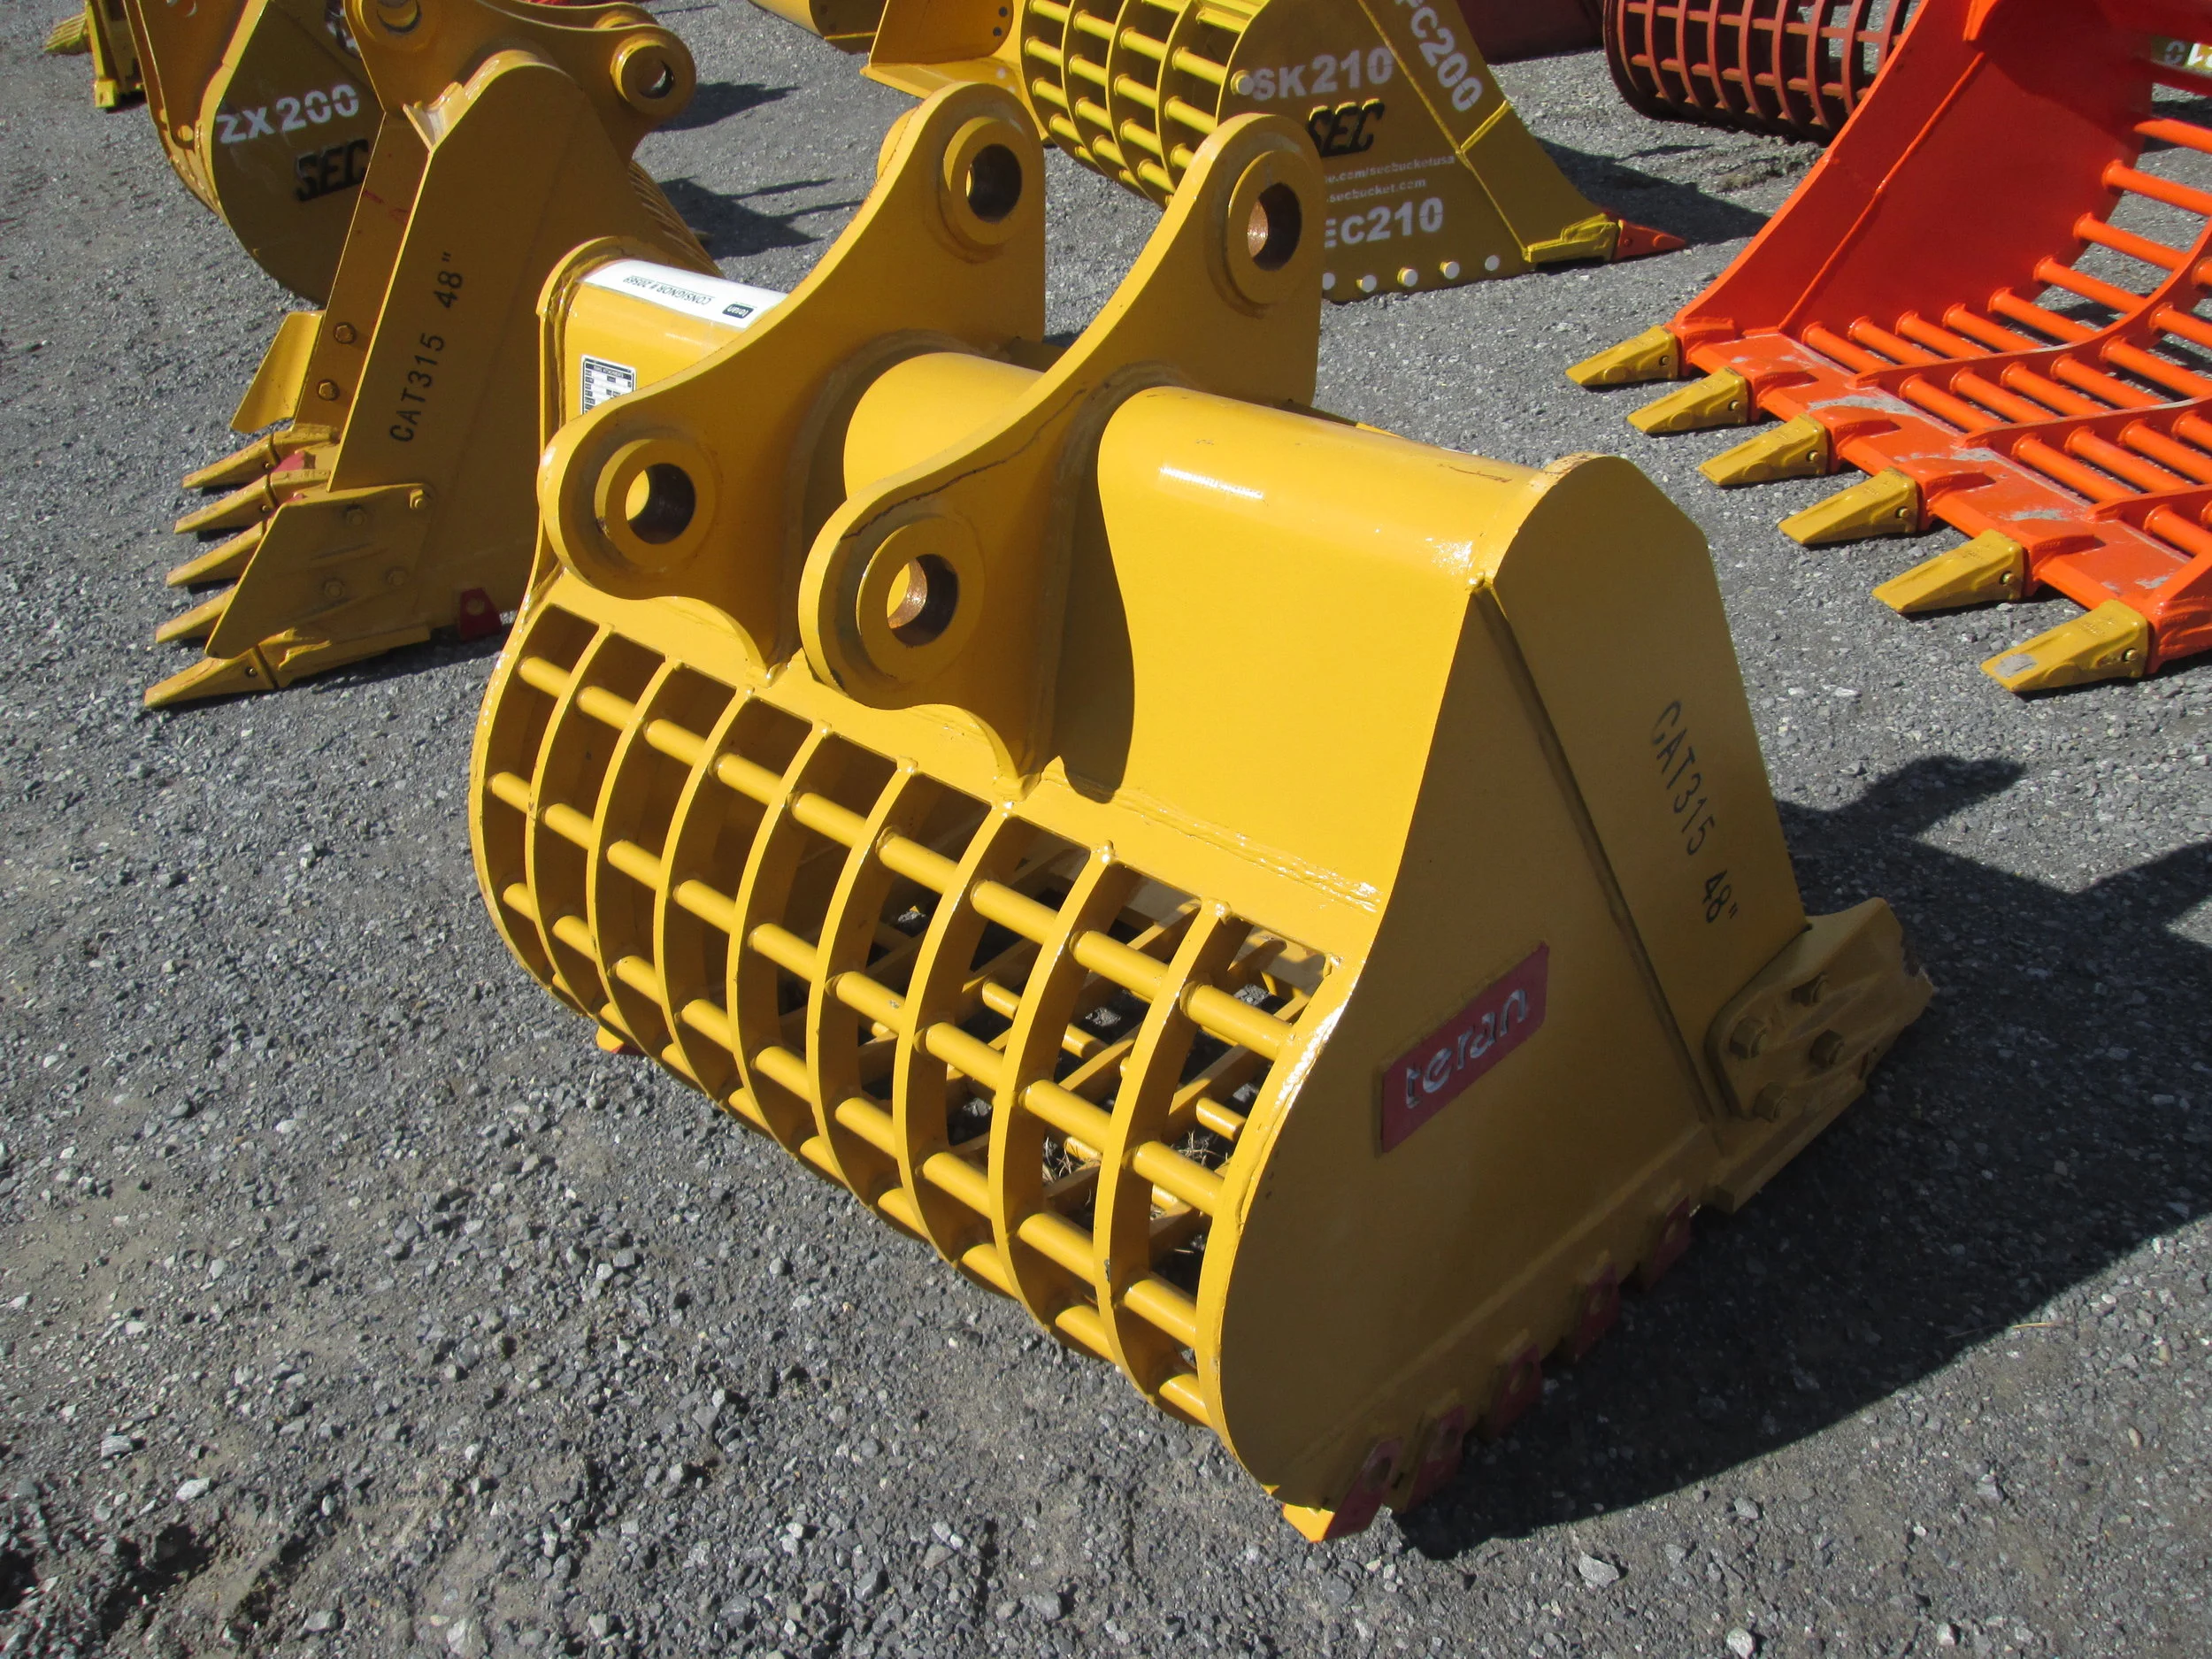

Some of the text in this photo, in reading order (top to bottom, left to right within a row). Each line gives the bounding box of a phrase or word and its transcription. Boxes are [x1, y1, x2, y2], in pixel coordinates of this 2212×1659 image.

[1252, 47, 1394, 101] SK210
[1394, 0, 1483, 112] C200
[296, 139, 369, 202] SEC
[1307, 97, 1385, 157] SEC
[657, 284, 712, 305] CONSIGNOR
[389, 251, 463, 442] CAT315 48"
[1651, 700, 1739, 924] CAT315 48"
[1406, 988, 1528, 1109] teran
